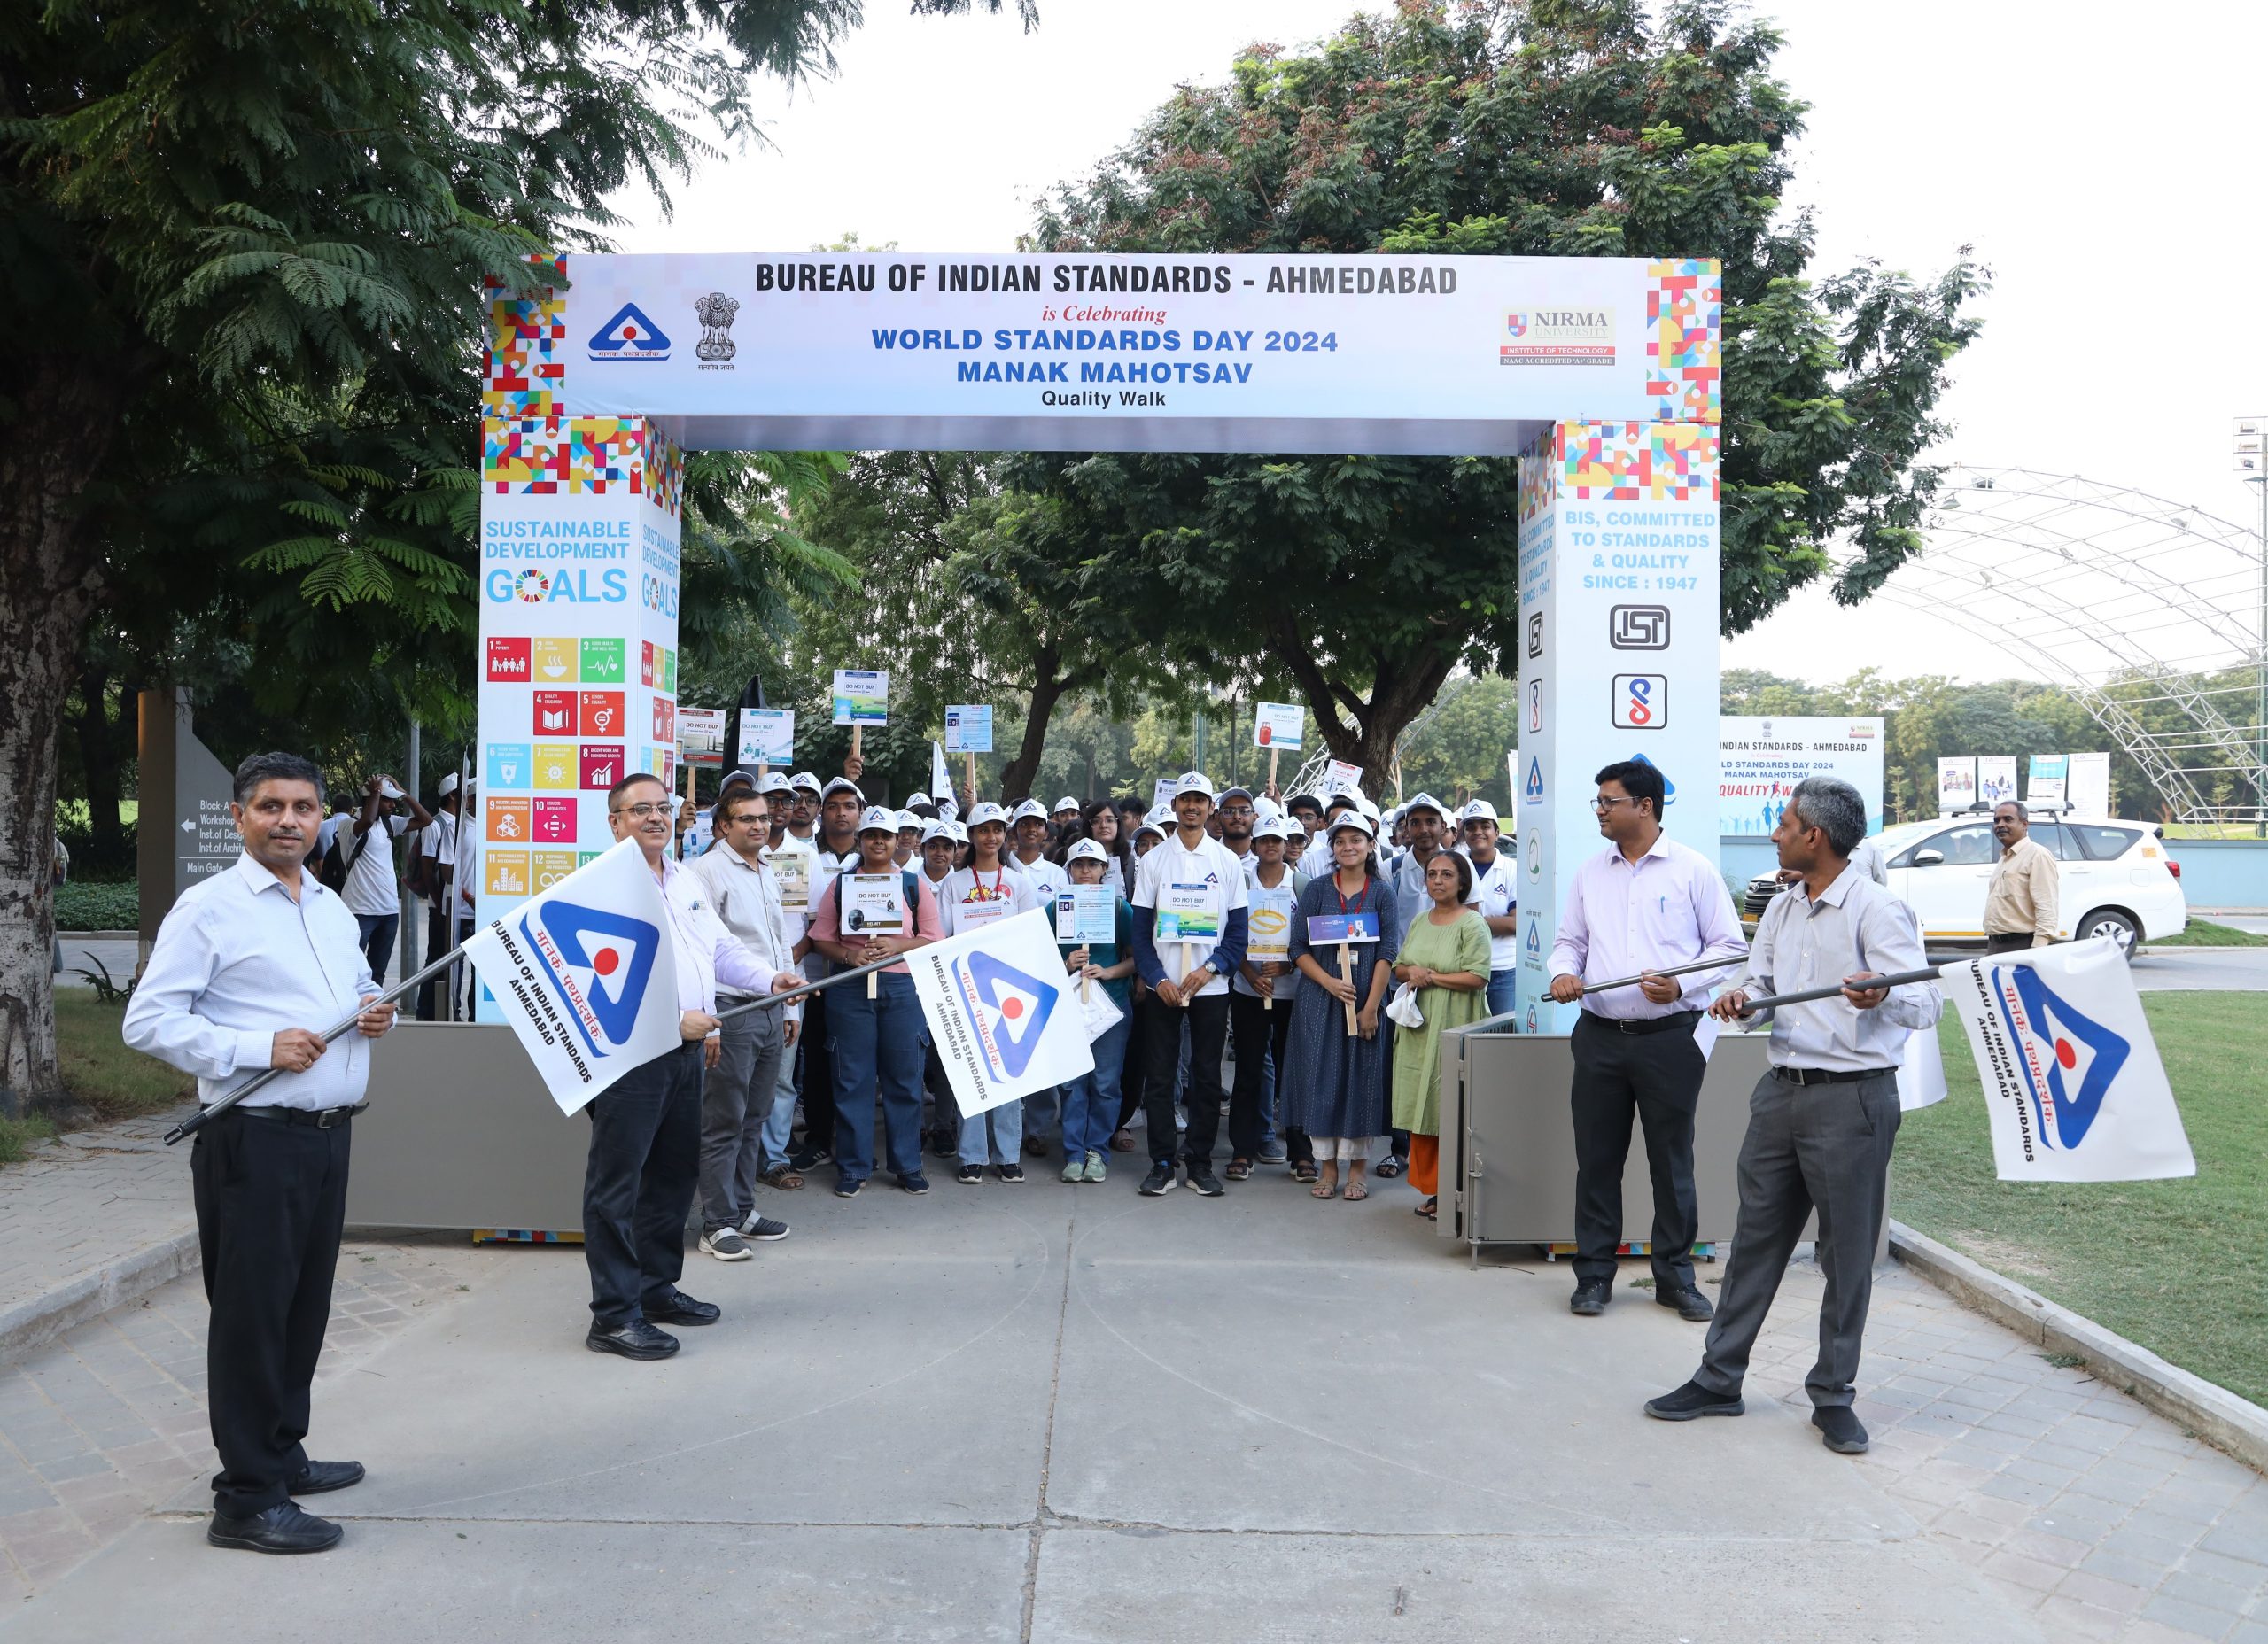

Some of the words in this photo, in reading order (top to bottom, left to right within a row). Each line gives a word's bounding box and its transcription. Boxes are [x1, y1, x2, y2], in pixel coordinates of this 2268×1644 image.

[757, 264, 874, 291] BUREAU
[889, 264, 925, 291] OF
[939, 265, 1040, 291] INDIAN
[1054, 265, 1231, 293] STANDARDS
[1267, 267, 1456, 294] AHMEDABAD
[1043, 306, 1056, 321] is
[1063, 306, 1166, 325] Celebrating
[1535, 313, 1608, 326] NIRMA
[872, 329, 982, 350] WORLD
[995, 330, 1180, 351] STANDARDS
[1194, 331, 1254, 351] DAY
[1265, 331, 1338, 352] 2024
[1535, 327, 1608, 337] UNIVERSITY
[958, 362, 1068, 382] MANAK
[1081, 362, 1252, 383] MAHOTSAV
[1042, 391, 1111, 409] Quality
[1119, 392, 1165, 406] Walk
[1565, 511, 1601, 526] BIS,
[1606, 512, 1715, 526] COMMITTED
[486, 521, 630, 538] SUSTAINABLE
[1528, 515, 1554, 543] COMMITTED
[643, 524, 679, 560] SUSTAINABLE
[1572, 532, 1595, 546] TO
[1601, 533, 1709, 547] STANDARDS
[486, 542, 630, 559] DEVELOPMENT
[1527, 535, 1552, 563] STANDARDS
[642, 546, 679, 579] DEVELOPMENT
[1592, 554, 1604, 567] &
[1612, 555, 1689, 569] QUALITY
[1528, 560, 1547, 582] QUALITY
[486, 569, 627, 602] GOALS
[1583, 576, 1637, 589] SINCE
[1657, 578, 1697, 590] 1947
[642, 573, 677, 619] GOALS
[1523, 586, 1535, 606] SINCE
[1539, 579, 1550, 596] 1947
[490, 640, 494, 650] 1
[584, 641, 589, 651] 3
[536, 694, 541, 703] 4
[584, 694, 589, 704] 5
[584, 748, 588, 757] 8
[1720, 741, 1749, 750] INDIAN
[1752, 741, 1803, 751] STANDARDS
[1813, 743, 1868, 752] AHMEDABAD
[1720, 785, 1769, 796] QUALITY
[200, 800, 229, 810] Block-A
[490, 801, 494, 810] 9
[535, 801, 544, 810] 10
[200, 814, 235, 826] Workshop
[199, 828, 214, 839] Inst.
[214, 829, 222, 839] of
[198, 842, 214, 853] Inst.
[214, 842, 222, 852] of
[488, 854, 495, 863] 11
[535, 855, 543, 864] 12
[187, 862, 205, 873] Main
[206, 862, 223, 872] Gate
[1971, 958, 1992, 1008] BUREAU
[491, 919, 523, 965] BUREAU
[520, 965, 533, 985] OF
[530, 984, 557, 1022] INDIAN
[554, 1021, 592, 1084] STANDARDS
[509, 978, 555, 1046] AHMEDABAD
[1987, 1012, 1999, 1029] OF
[931, 955, 951, 994] BUREAU
[945, 995, 956, 1008] OF
[951, 1007, 968, 1043] INDIAN
[962, 1043, 988, 1101] STANDARDS
[936, 1002, 962, 1060] AHMEDABAD
[1977, 1017, 2010, 1099] AHMEDABAD
[1992, 1032, 2015, 1078] INDIAN
[2010, 1082, 2034, 1163] STANDARDS
